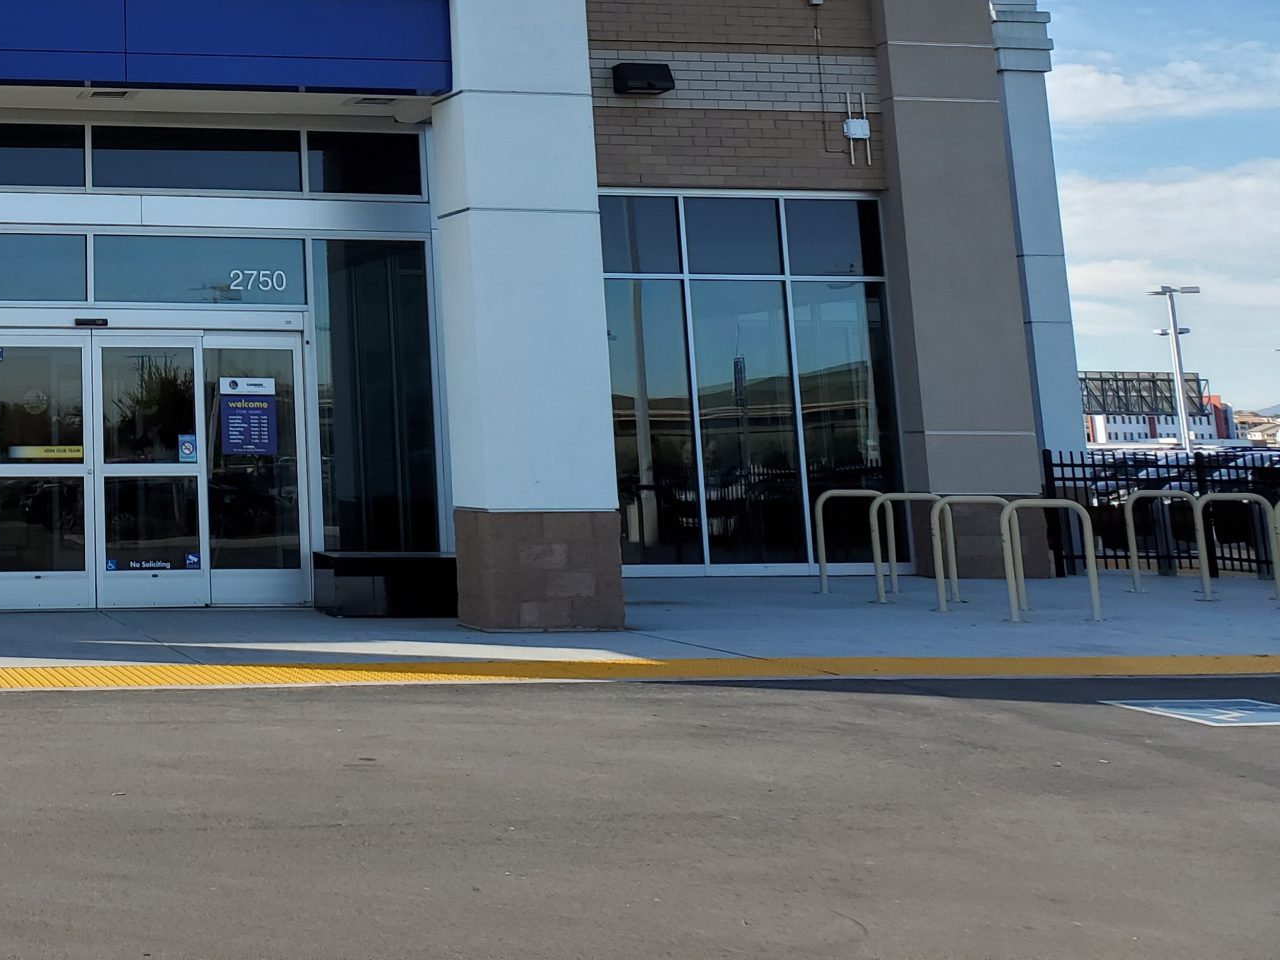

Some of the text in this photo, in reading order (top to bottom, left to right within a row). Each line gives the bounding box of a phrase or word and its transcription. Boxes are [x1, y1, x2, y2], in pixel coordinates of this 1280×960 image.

[230, 270, 286, 290] 2750
[228, 399, 269, 409] welcome
[141, 560, 171, 569] Soliciting
